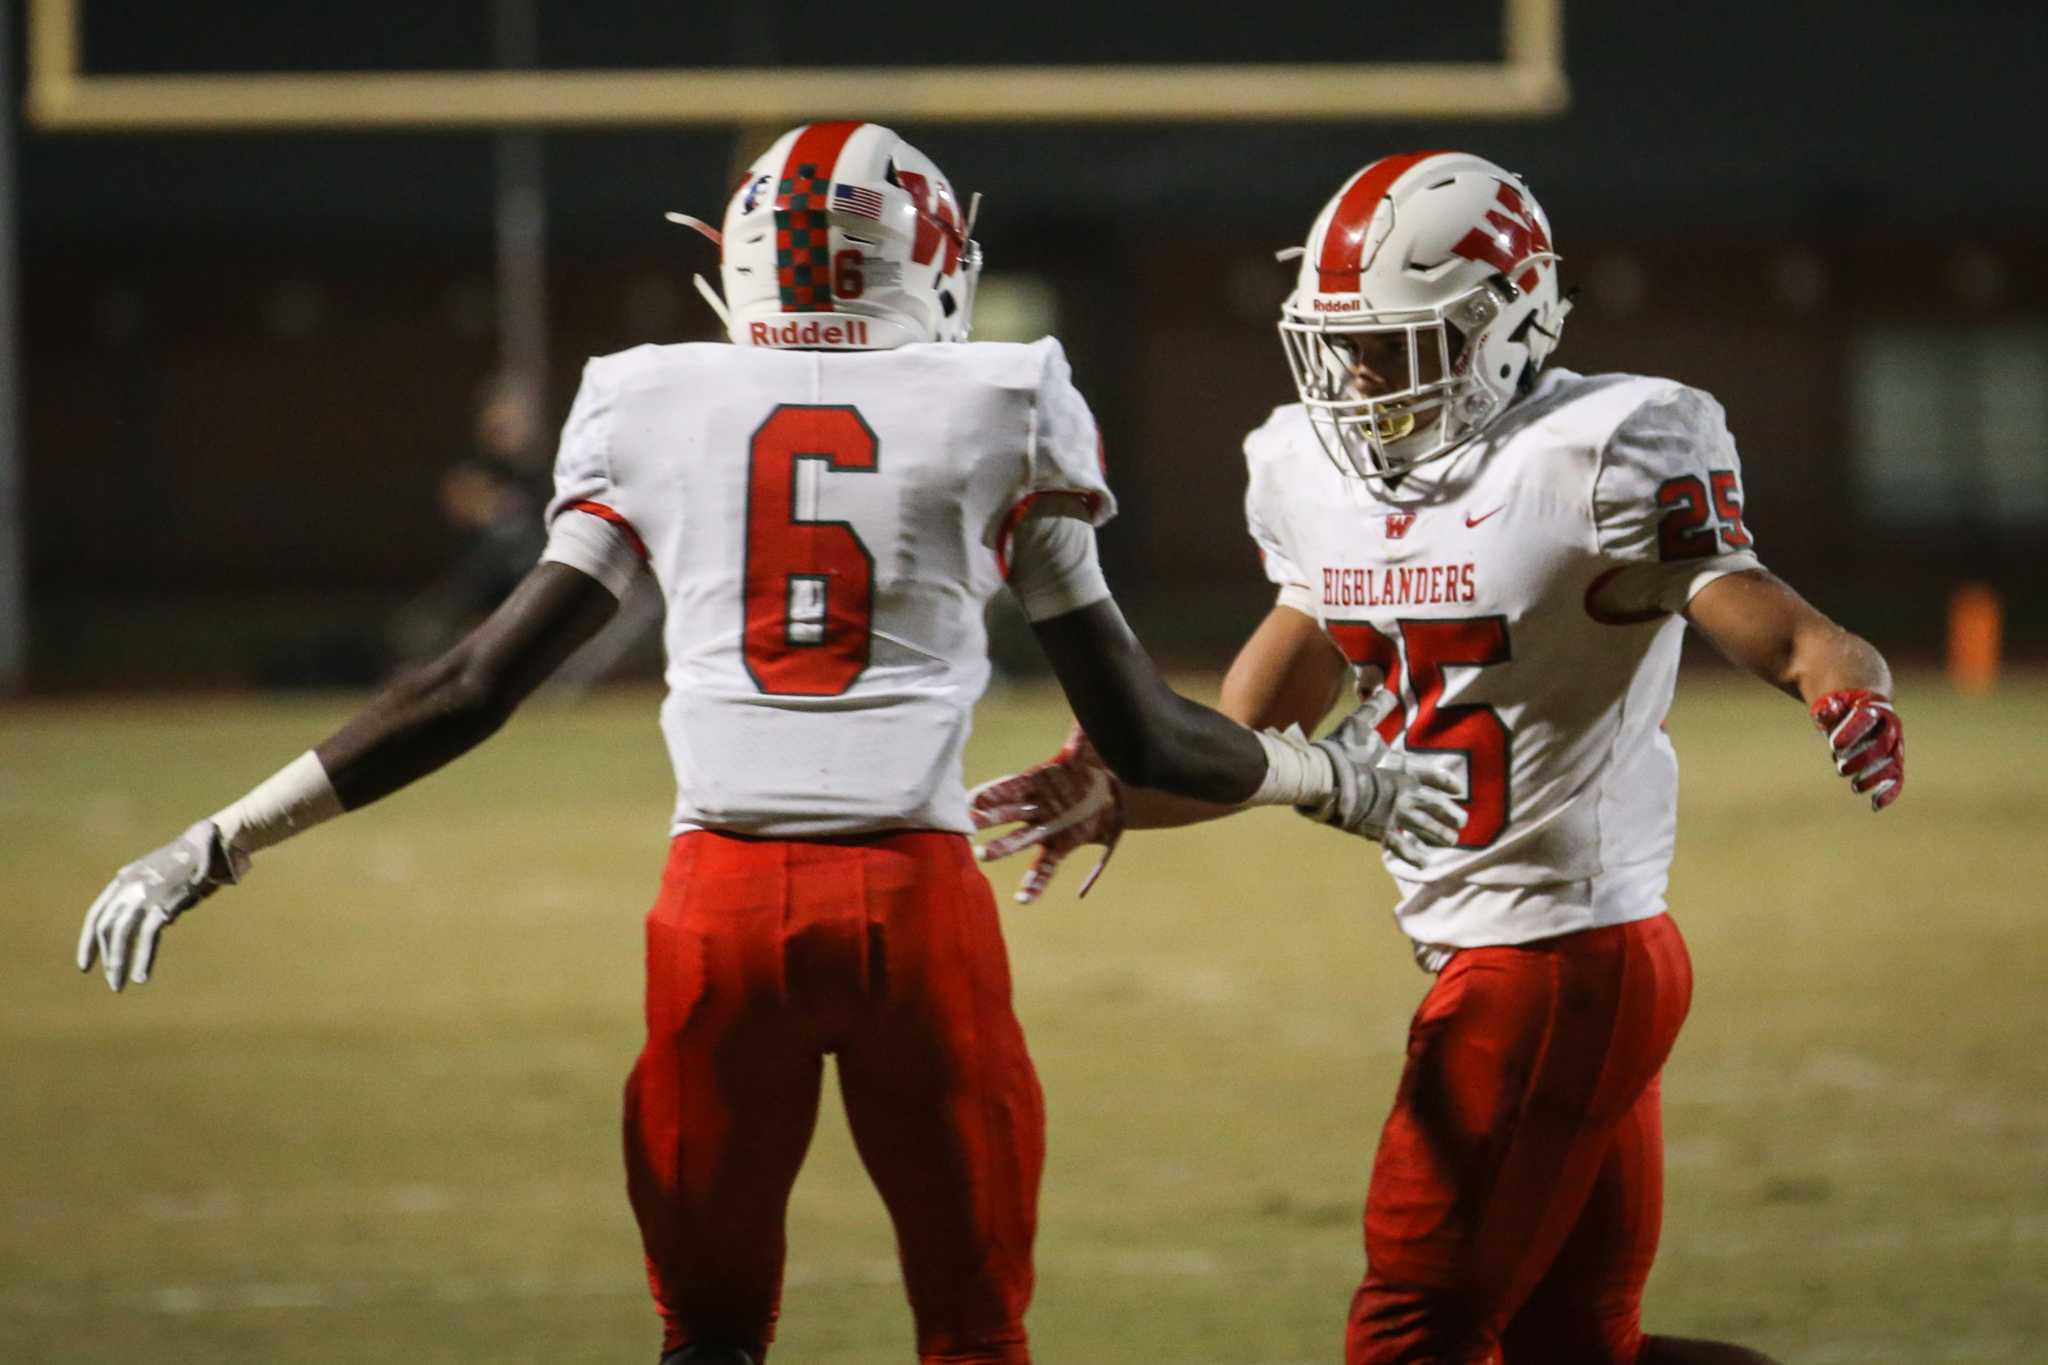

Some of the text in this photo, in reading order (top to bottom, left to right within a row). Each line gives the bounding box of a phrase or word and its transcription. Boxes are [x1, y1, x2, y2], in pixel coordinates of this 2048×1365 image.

[835, 249, 865, 299] 6
[1313, 299, 1361, 312] Riddell
[750, 321, 867, 346] Riddell
[1385, 512, 1416, 539] W
[1656, 469, 1751, 562] 25
[741, 403, 879, 695] 6
[1322, 563, 1476, 606] HIGHLANDERS
